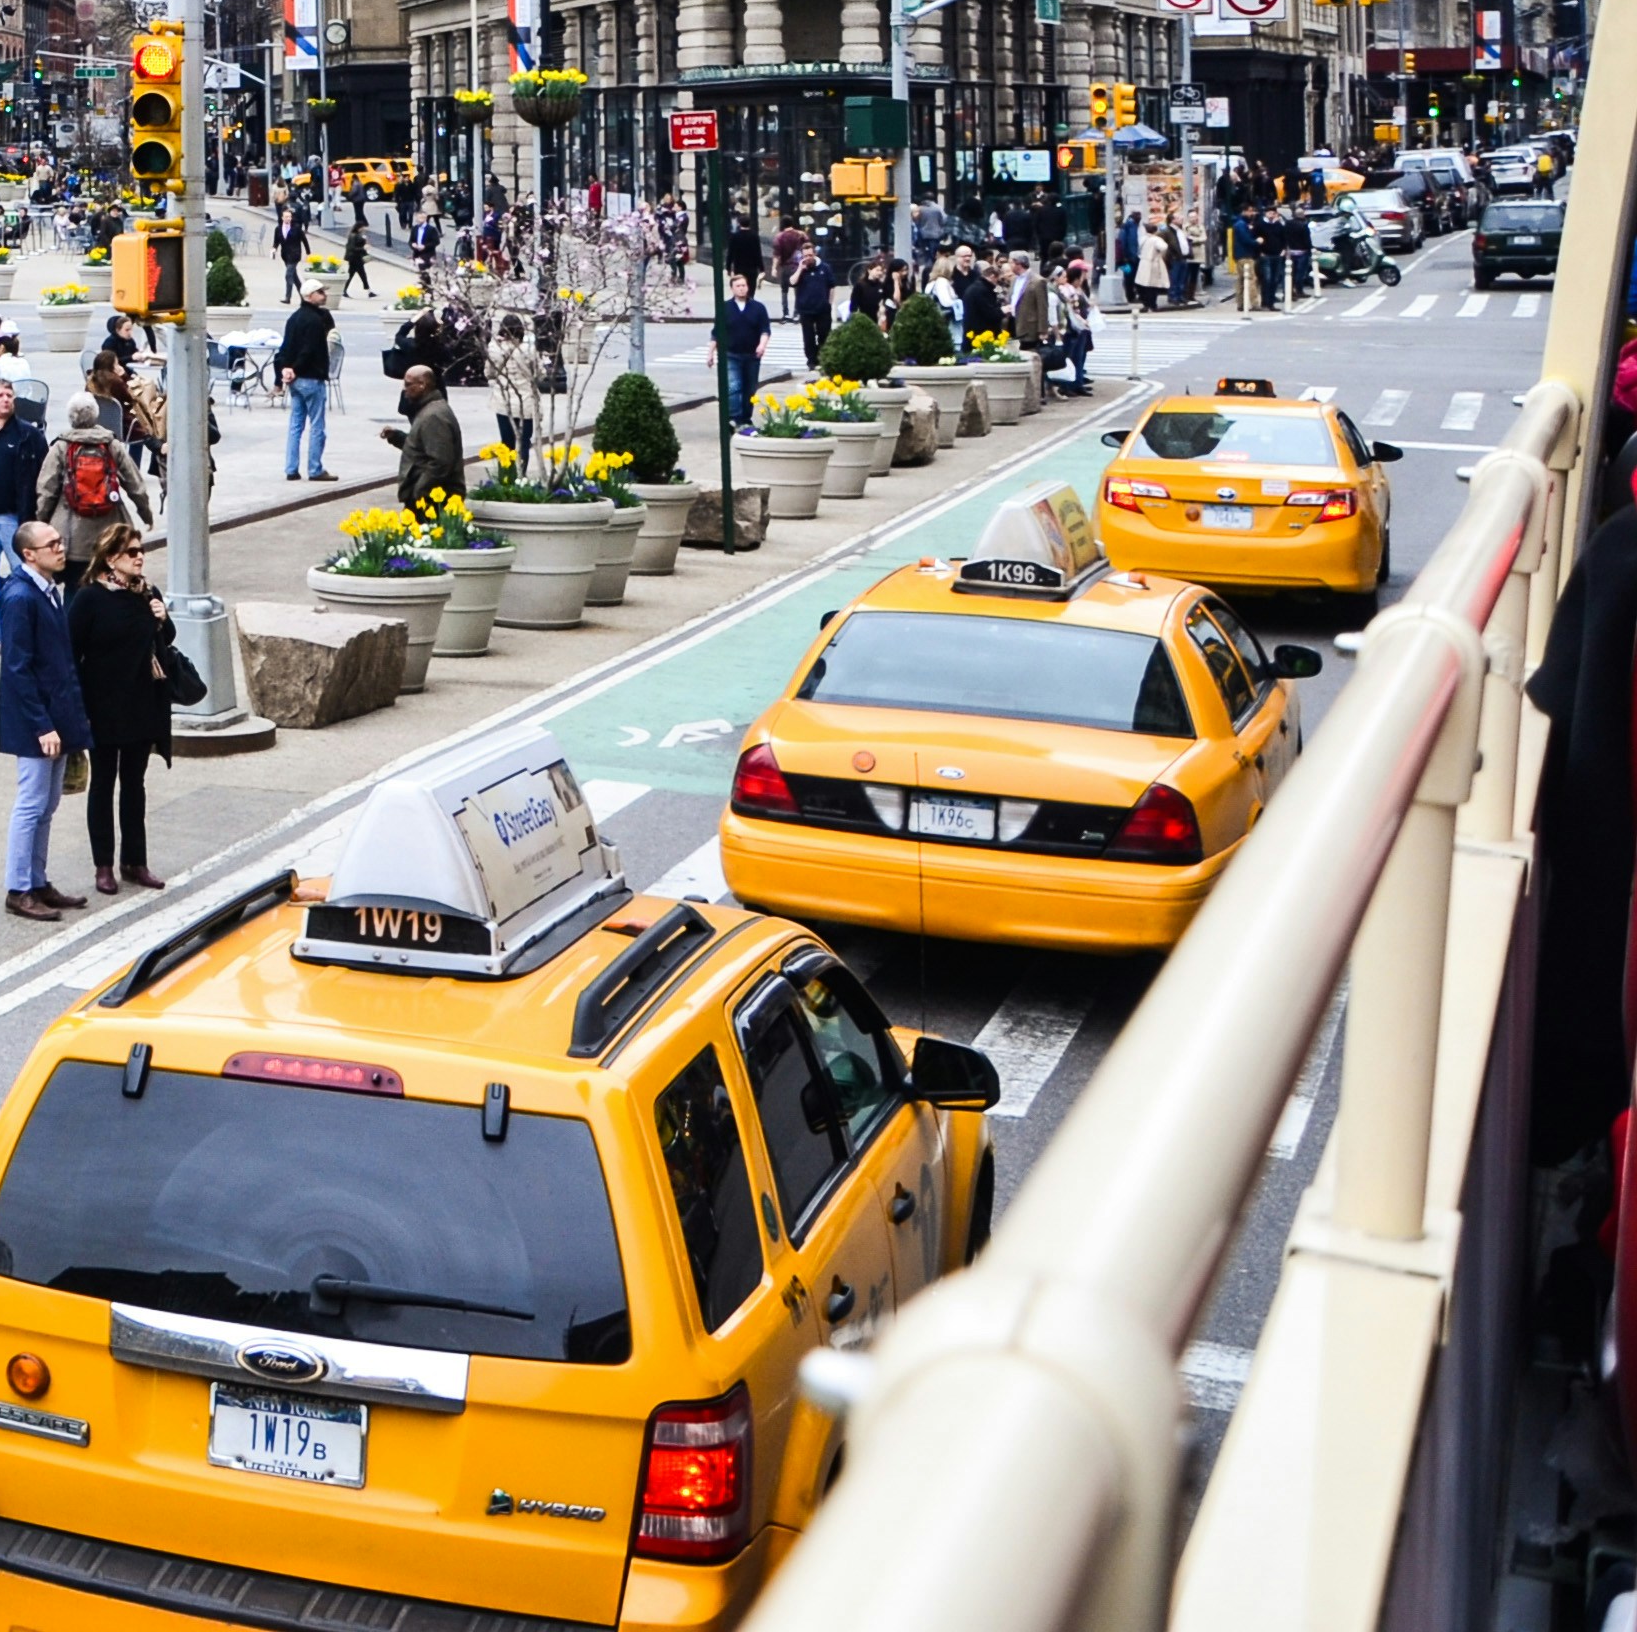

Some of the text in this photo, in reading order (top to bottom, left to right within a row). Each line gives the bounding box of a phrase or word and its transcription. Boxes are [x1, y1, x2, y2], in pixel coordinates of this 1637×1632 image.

[673, 115, 713, 125] NO STOPPING
[680, 126, 707, 136] ANYTIME
[987, 562, 1036, 583] 1K96
[504, 797, 559, 842] StreetEasy
[354, 905, 443, 943] 1W19
[258, 1353, 299, 1371] Ford
[248, 1396, 282, 1413] NEW
[288, 1401, 327, 1419] YORK
[517, 1498, 607, 1522] HYBRID
